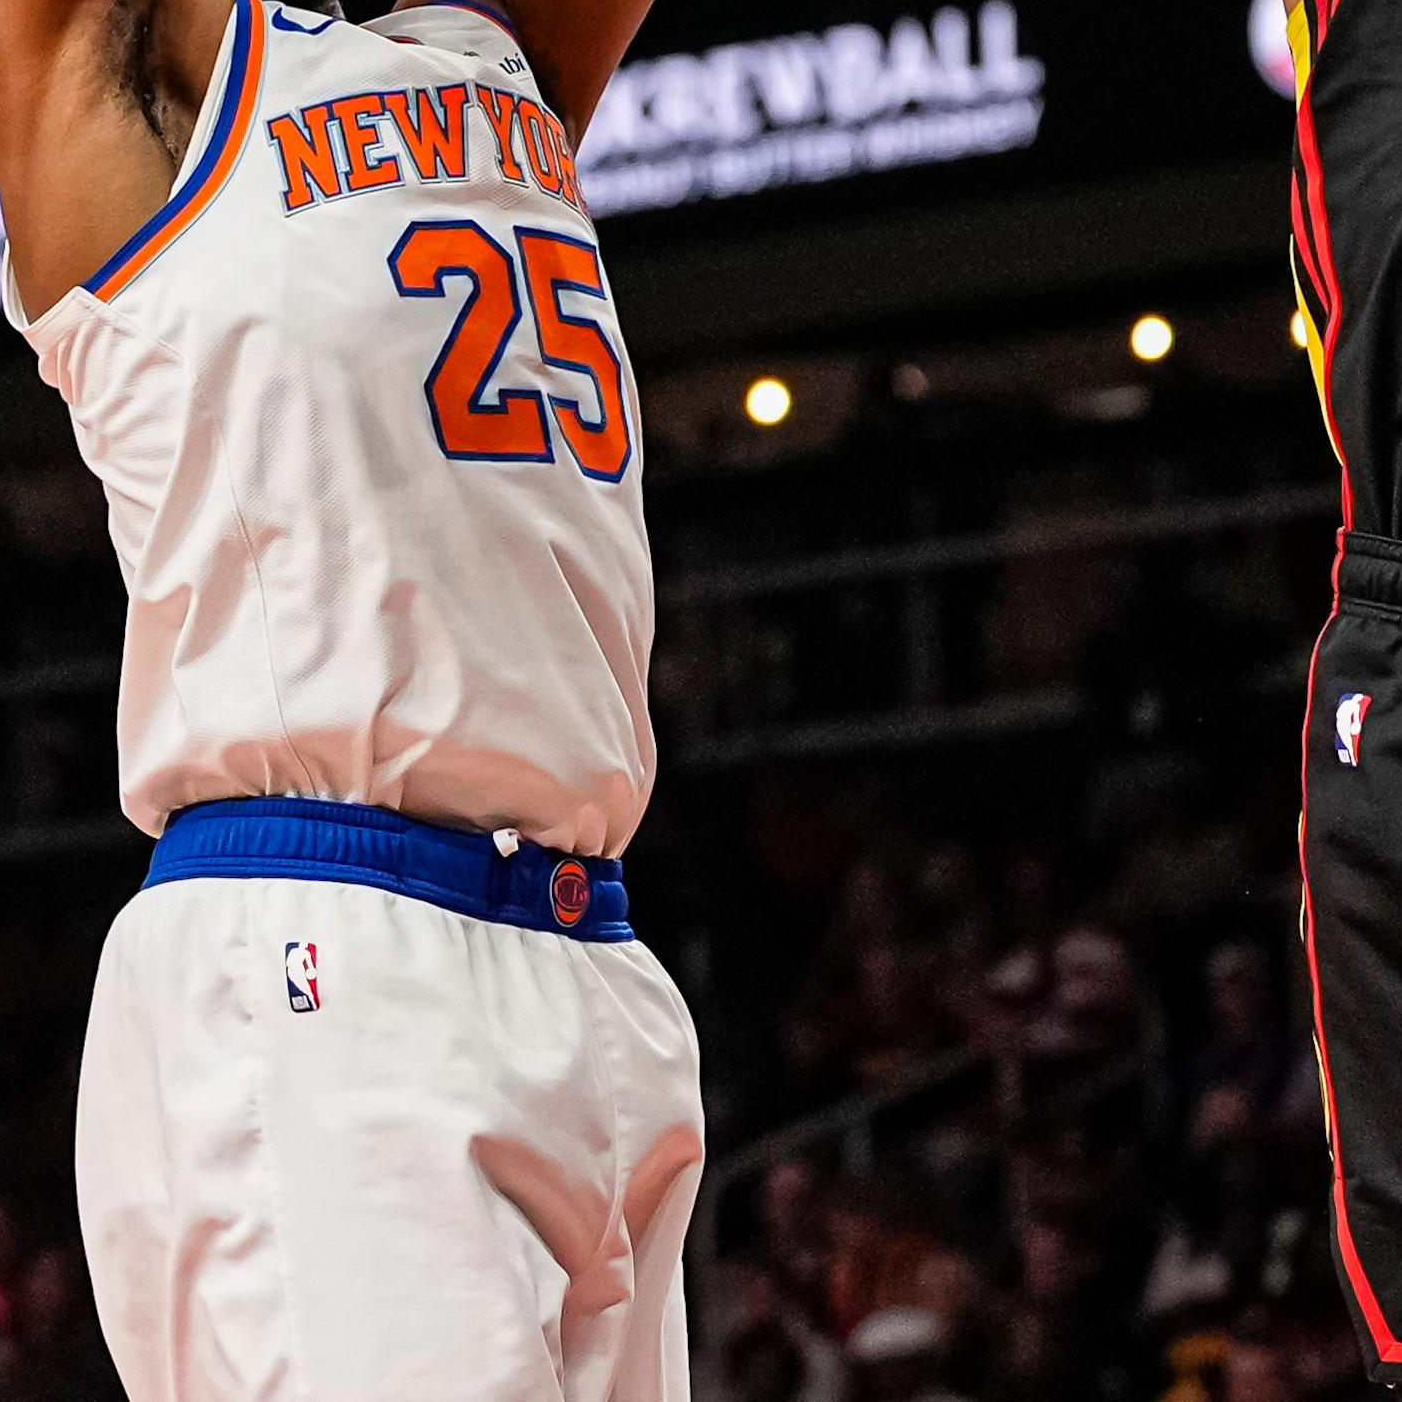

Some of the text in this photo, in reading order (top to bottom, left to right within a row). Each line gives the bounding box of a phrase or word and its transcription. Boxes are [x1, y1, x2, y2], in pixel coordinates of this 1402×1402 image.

[267, 81, 594, 224] NEW YOR
[387, 219, 633, 484] 25
